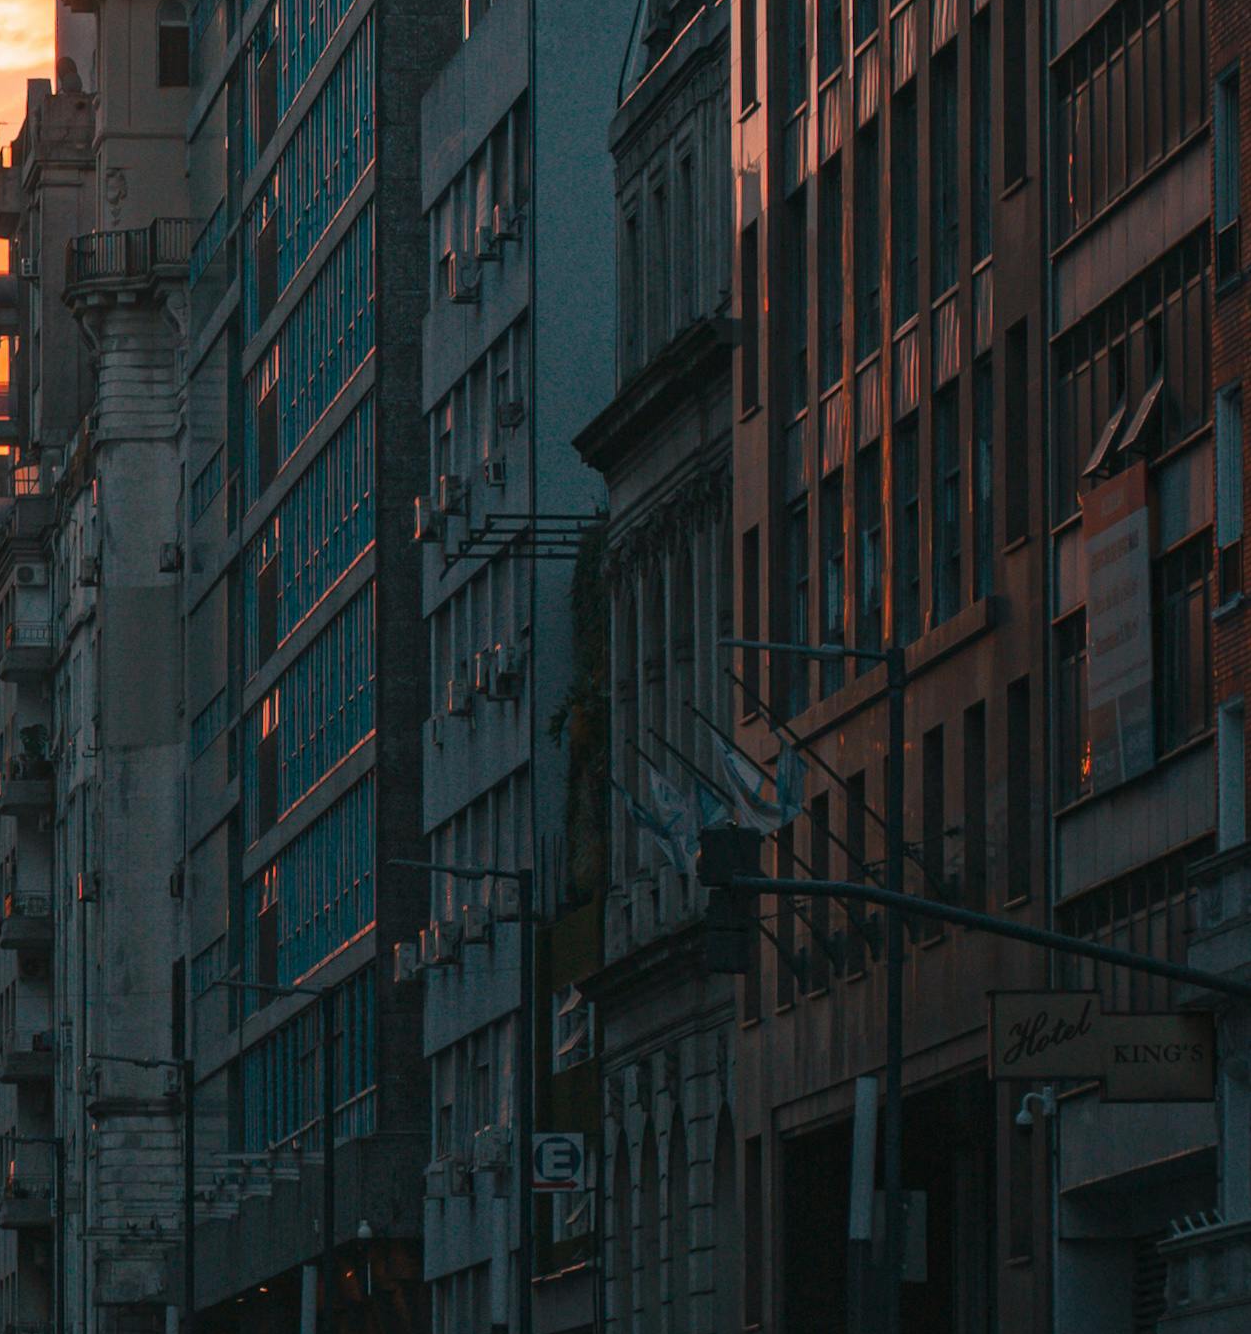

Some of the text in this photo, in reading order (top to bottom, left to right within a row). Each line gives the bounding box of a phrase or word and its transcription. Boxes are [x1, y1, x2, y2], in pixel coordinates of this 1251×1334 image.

[1003, 998, 1205, 1064] Hotel KING'S
[542, 1142, 573, 1178] E
